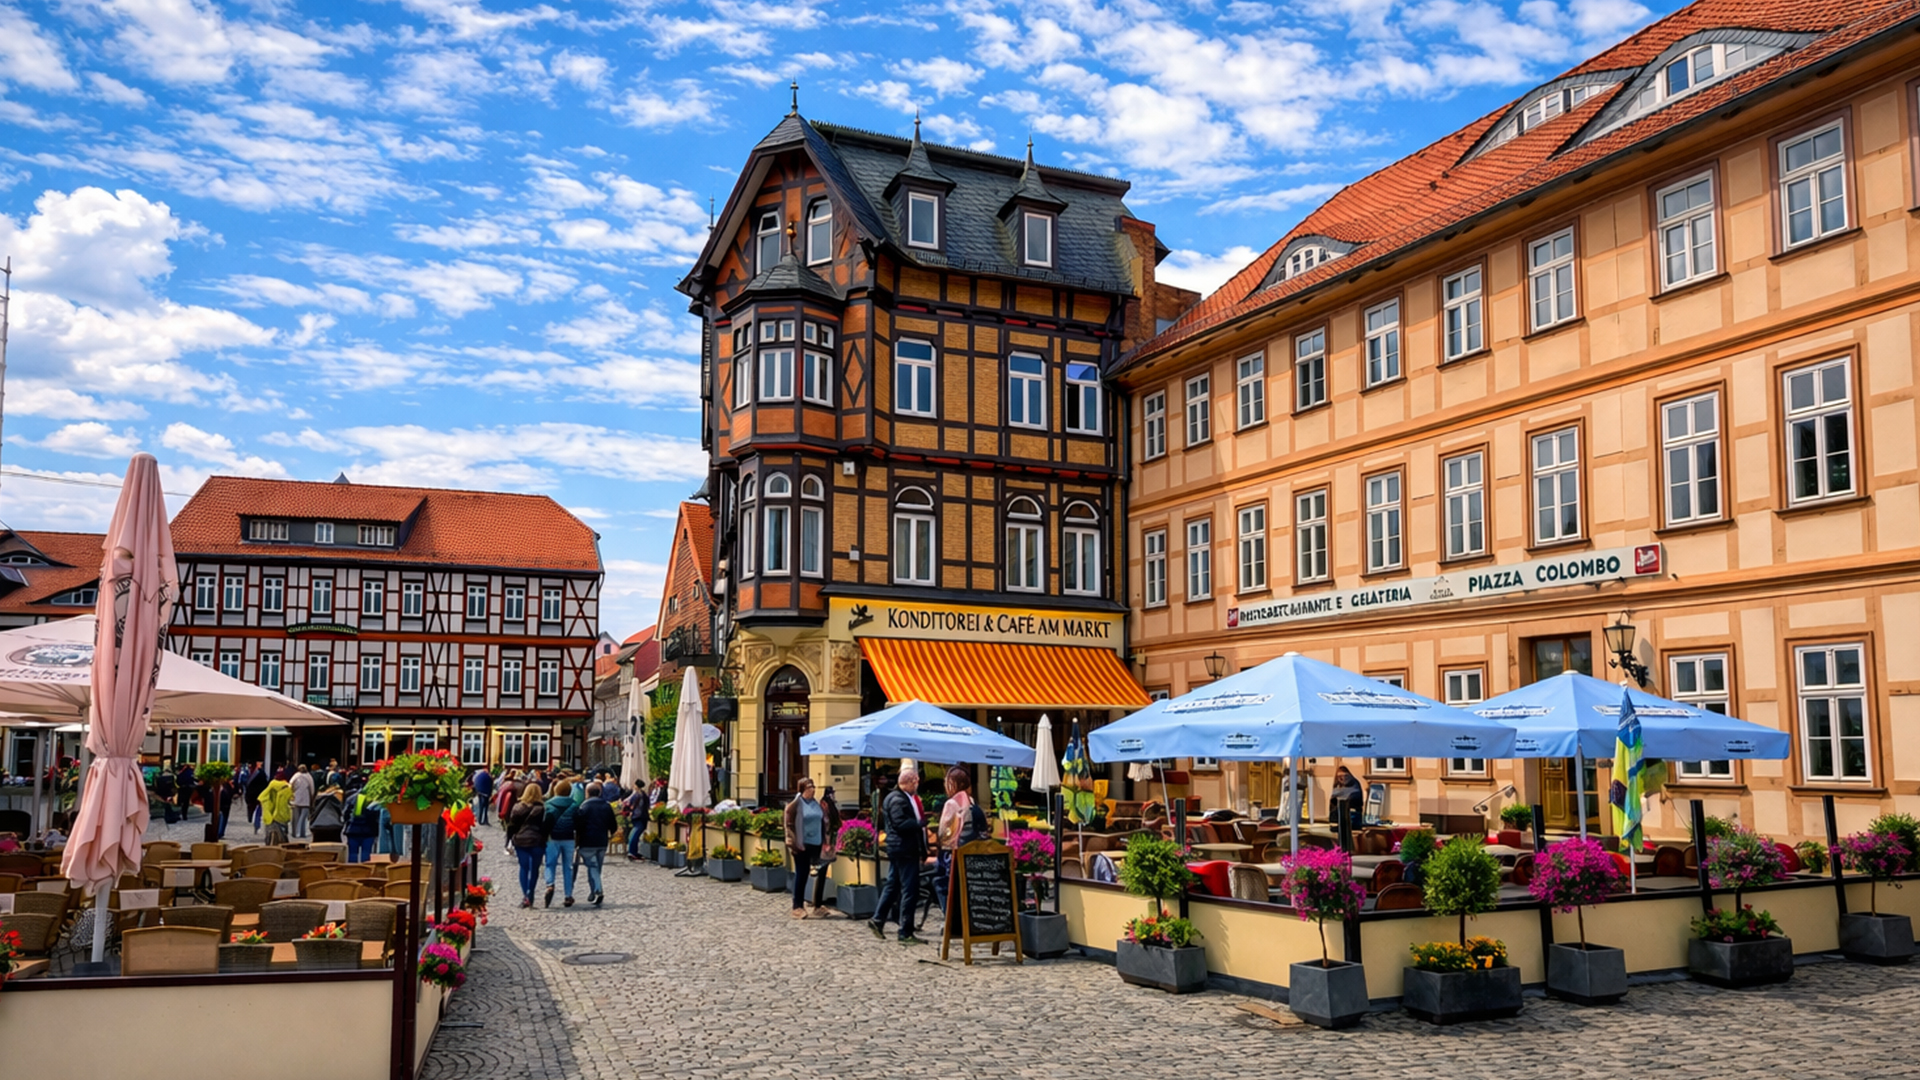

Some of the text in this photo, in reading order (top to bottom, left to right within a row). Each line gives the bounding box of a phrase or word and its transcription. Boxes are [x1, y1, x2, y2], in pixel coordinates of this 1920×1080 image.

[1468, 570, 1524, 593] PIAZZA
[1536, 555, 1621, 582] COLOMBO
[888, 608, 980, 631] KONDITOREI
[983, 614, 994, 632] &
[997, 613, 1036, 634] CAFÉ
[1038, 618, 1060, 636] AM
[1062, 620, 1112, 638] MARKT
